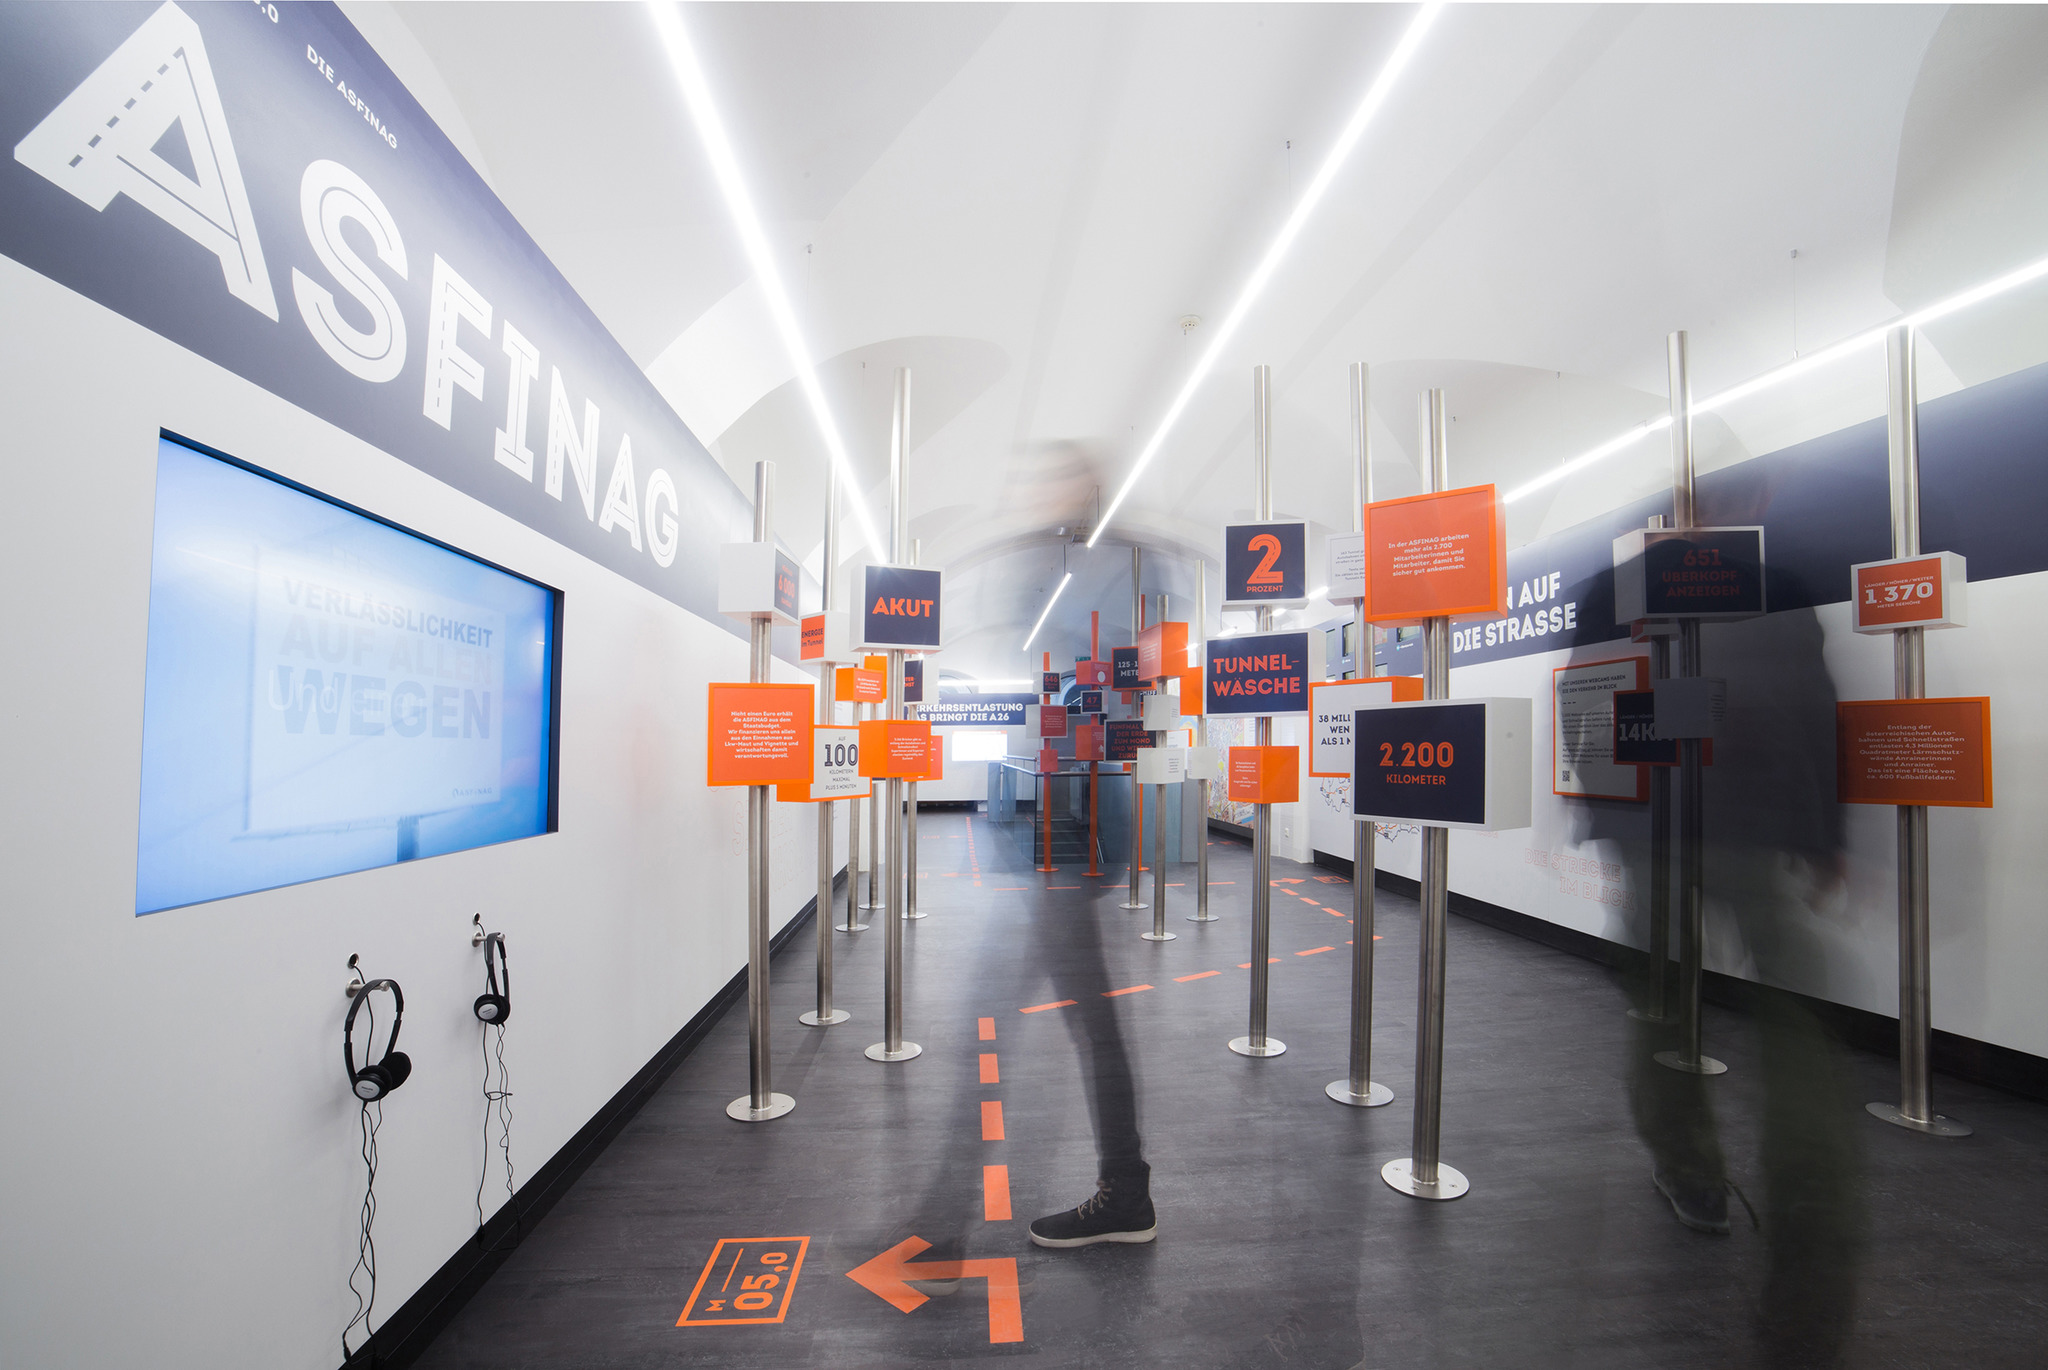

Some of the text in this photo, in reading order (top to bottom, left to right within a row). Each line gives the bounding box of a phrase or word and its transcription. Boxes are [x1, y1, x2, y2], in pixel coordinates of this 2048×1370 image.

[307, 44, 398, 149] DIE ASFINAG
[14, 1, 679, 568] ASFINAG
[1393, 551, 1449, 562] Mitarbeiterinnen
[1433, 542, 1453, 550] 2.700
[1683, 548, 1722, 566] 651
[1246, 533, 1284, 584] 2
[1246, 585, 1284, 593] PROZENT
[1518, 571, 1561, 608] AUF
[1666, 585, 1740, 597] ANZEIGEN
[1865, 582, 1934, 605] 1.370
[283, 576, 493, 648] VERLÄSSLICHKEIT
[872, 596, 934, 618] AKUT
[801, 628, 824, 639] ENERGIE
[1453, 602, 1577, 653] DIE STRASSE
[278, 613, 493, 686] AUF ALLEN
[1213, 654, 1300, 674] TUNNEL-
[1213, 676, 1301, 697] WÄSCHE
[277, 664, 492, 740] WEGEN
[929, 713, 968, 721] BRINGT
[970, 713, 987, 721] DIE
[1318, 715, 1329, 723] 38
[1320, 737, 1337, 745] ALS
[824, 744, 859, 767] 100
[1379, 741, 1454, 768] 2.200
[1386, 774, 1446, 785] KILOMETER
[1525, 848, 1621, 883] DIE STRECKE
[1559, 876, 1635, 911] IM BLICK
